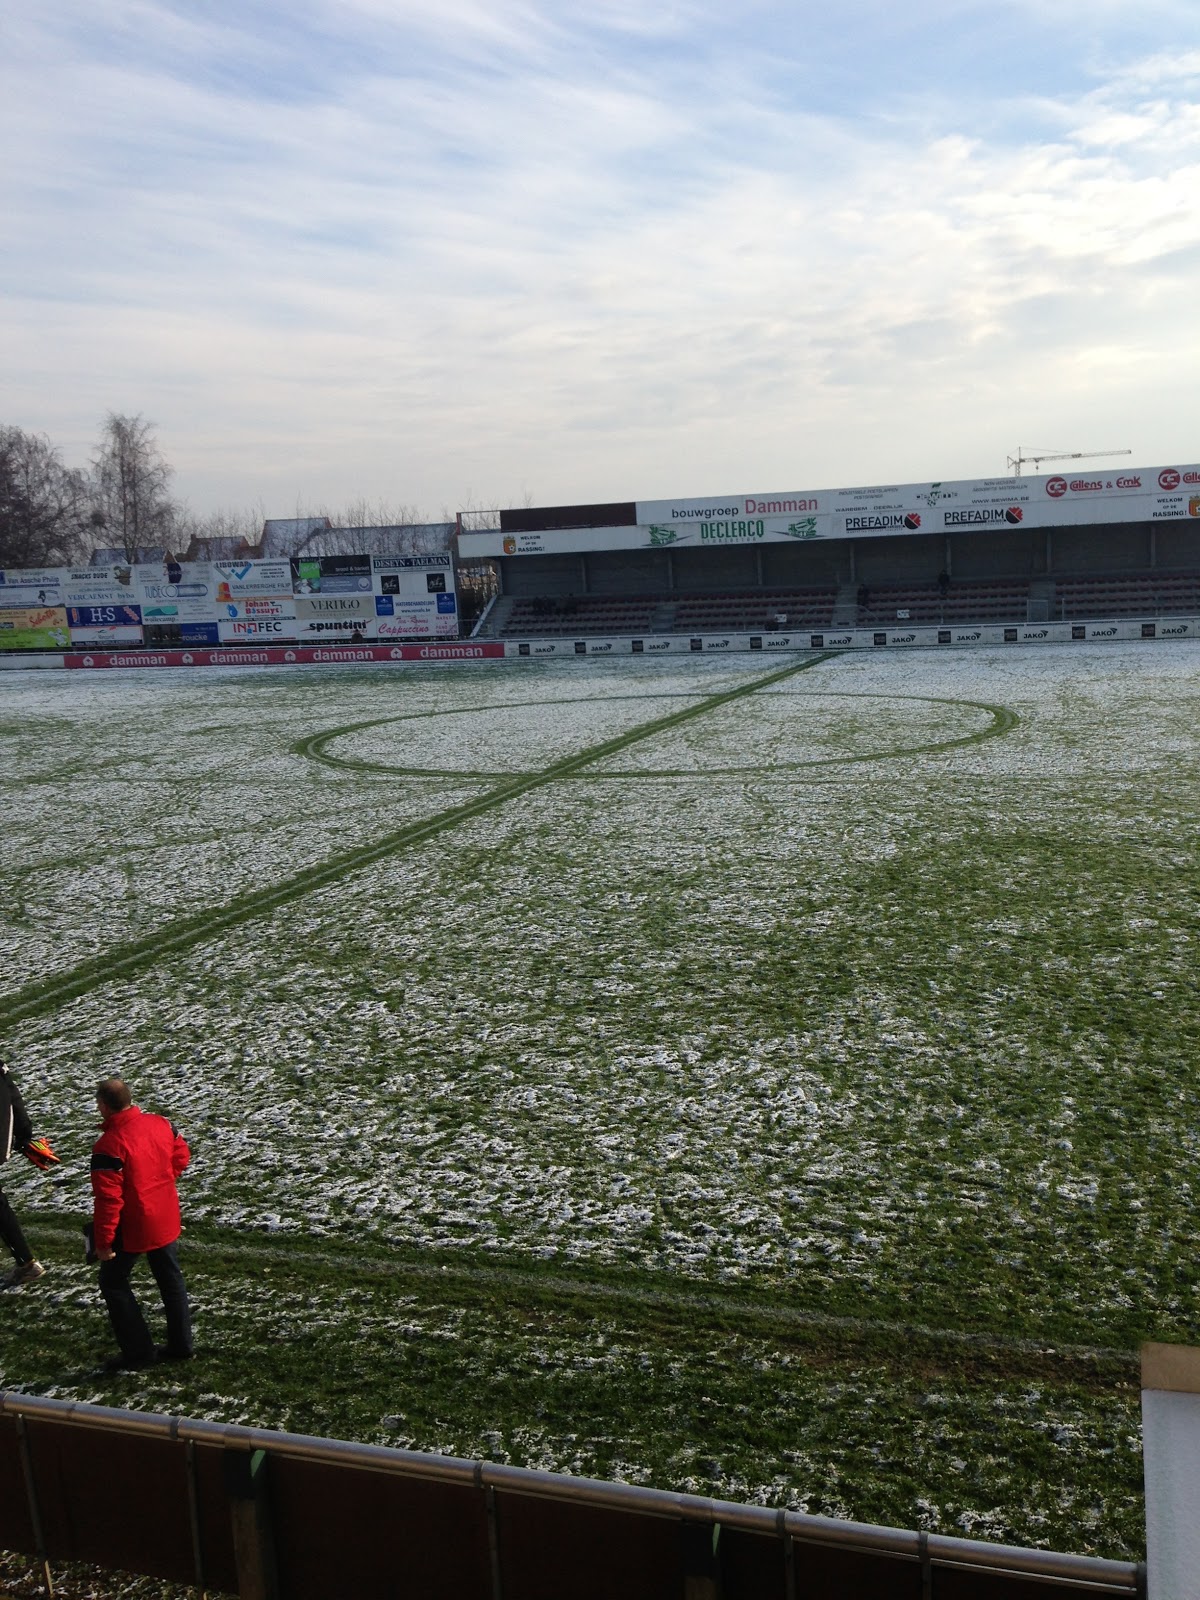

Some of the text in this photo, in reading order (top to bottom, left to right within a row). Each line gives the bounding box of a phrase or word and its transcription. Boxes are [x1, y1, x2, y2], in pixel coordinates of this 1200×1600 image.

[1070, 480, 1103, 491] Callens
[1106, 481, 1113, 489] &
[672, 499, 818, 519] bouwgroep Damman
[845, 515, 903, 528] PREFADIM
[944, 509, 1004, 522] PREFADIM
[701, 520, 764, 539] DECLERCQ
[375, 559, 406, 567] DESEYN
[412, 557, 448, 566] TAELMAN
[311, 600, 360, 610] VERTIGO
[90, 607, 116, 622] H-S
[309, 619, 367, 632] spuntini
[378, 623, 429, 636] Cappuccino
[209, 652, 269, 664] damman
[312, 650, 374, 661] damman
[420, 646, 484, 658] damman
[109, 655, 166, 666] damman
